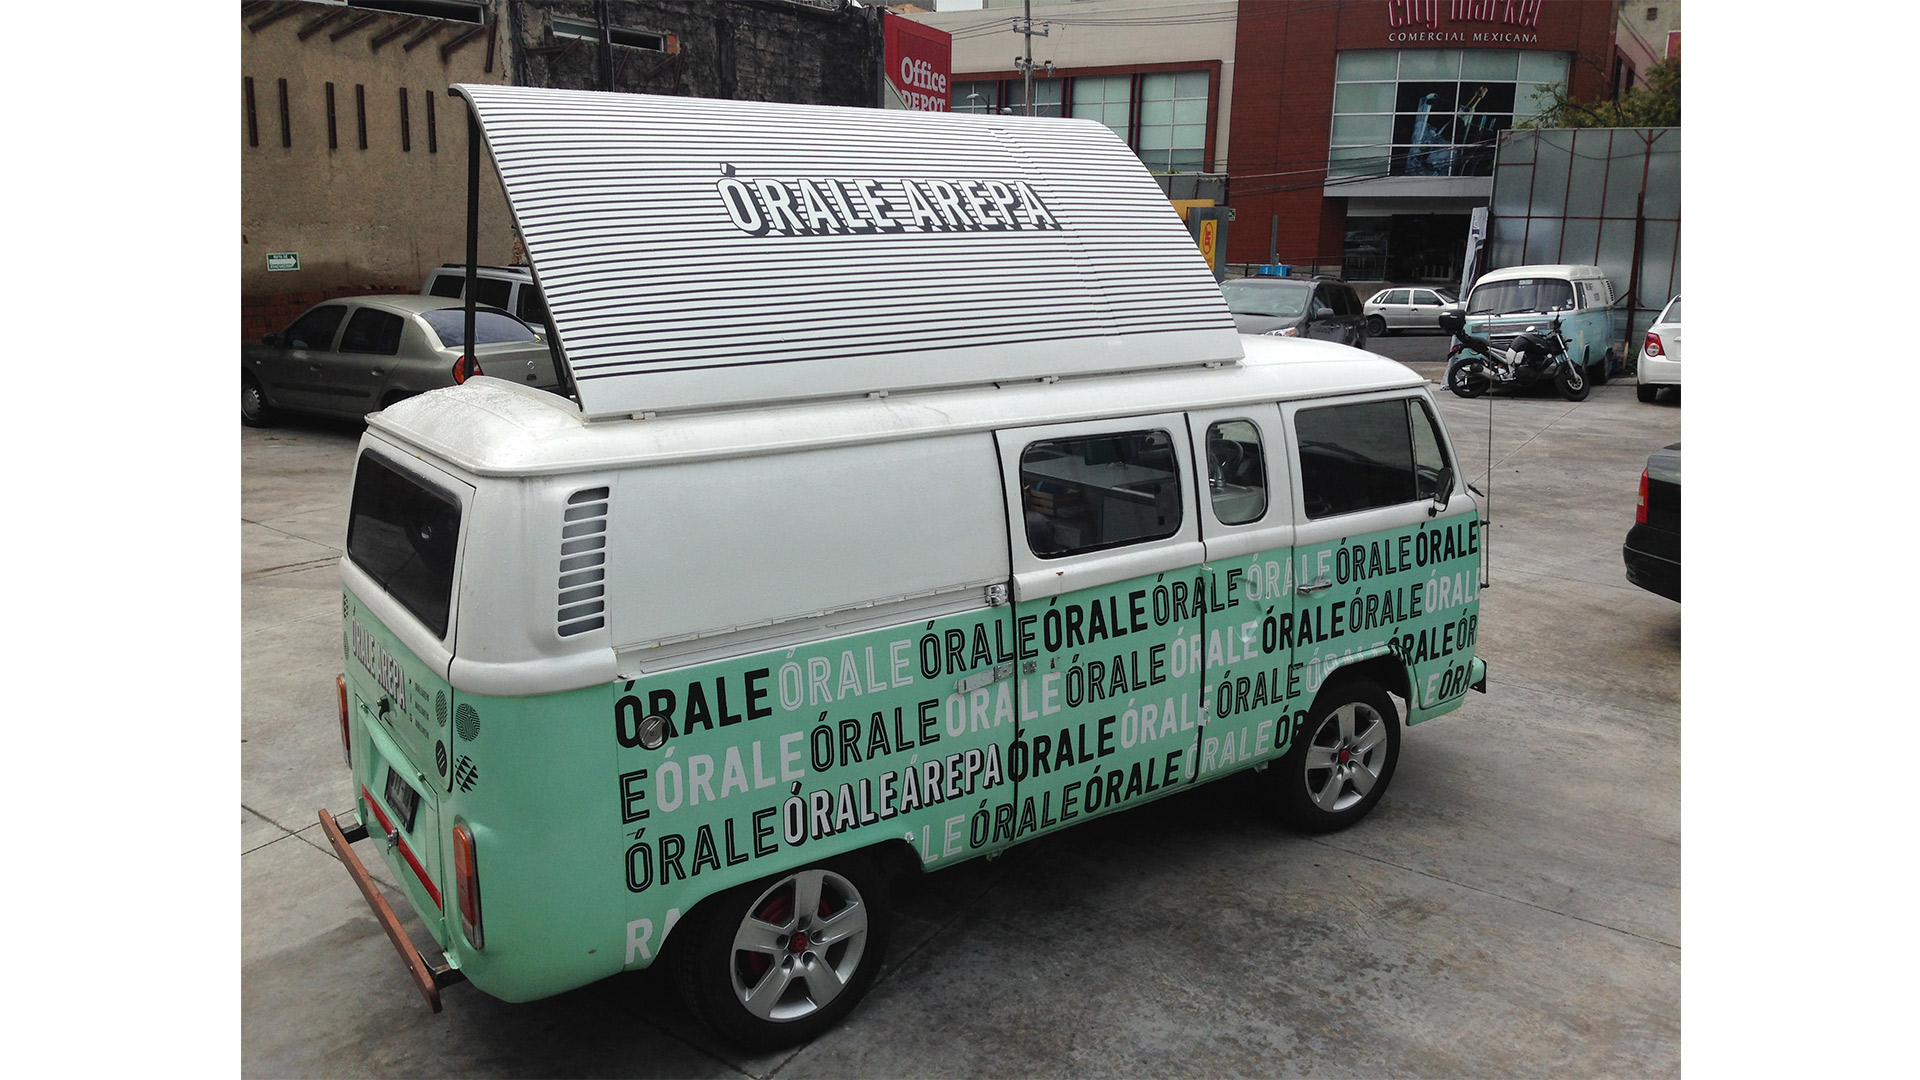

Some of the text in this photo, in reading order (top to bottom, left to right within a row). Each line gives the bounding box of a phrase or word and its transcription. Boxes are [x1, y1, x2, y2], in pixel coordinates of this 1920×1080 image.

[1388, 32, 1538, 43] COMERCIAL MEXICANA
[901, 56, 946, 93] Office
[901, 89, 946, 112] DEPOT
[716, 163, 1062, 236] ÓRALE AREPA
[615, 668, 772, 749] ÓRALE
[778, 639, 914, 711] ÓRALE
[919, 615, 1039, 680] ÓRALE
[1043, 590, 1148, 653] ÓRALE
[1152, 568, 1242, 626] ÓRALE
[1336, 535, 1411, 585] ÓRALE
[1416, 520, 1478, 568] ÓRALE
[377, 642, 407, 714] AREPA
[619, 768, 650, 824] E
[655, 731, 806, 813] ÓRALE
[810, 698, 940, 772] ÓRALE
[1066, 644, 1166, 708] ÓRALE
[1171, 620, 1259, 678] ÓRALE
[1262, 601, 1346, 654] ÓRALE
[1349, 583, 1423, 633] ÓRALE
[625, 806, 779, 893] ÓRALE
[783, 771, 898, 847] ÓRALE
[1008, 715, 1116, 783] ÓRALE
[1217, 662, 1304, 719] ÓRALE
[970, 781, 1081, 849] ÓRALE
[1083, 749, 1183, 813] ÓRALE
[1184, 720, 1272, 779] ÓRALE
